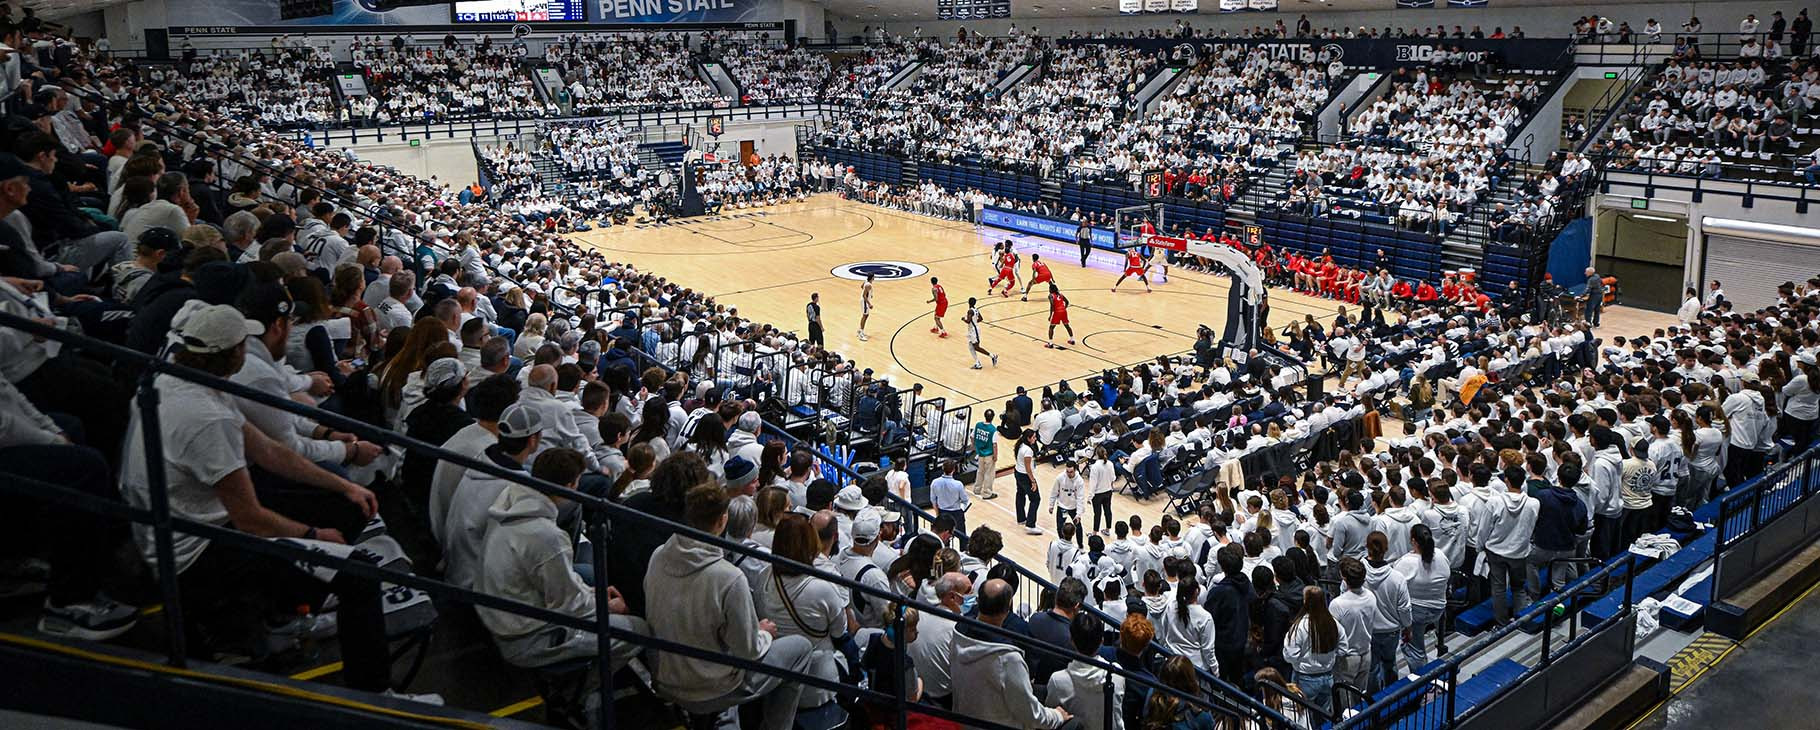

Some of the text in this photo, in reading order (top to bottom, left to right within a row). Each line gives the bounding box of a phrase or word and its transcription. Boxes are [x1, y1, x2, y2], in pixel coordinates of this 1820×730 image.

[599, 0, 662, 19] PENN
[306, 235, 327, 256] 70
[1056, 552, 1063, 571] 1
